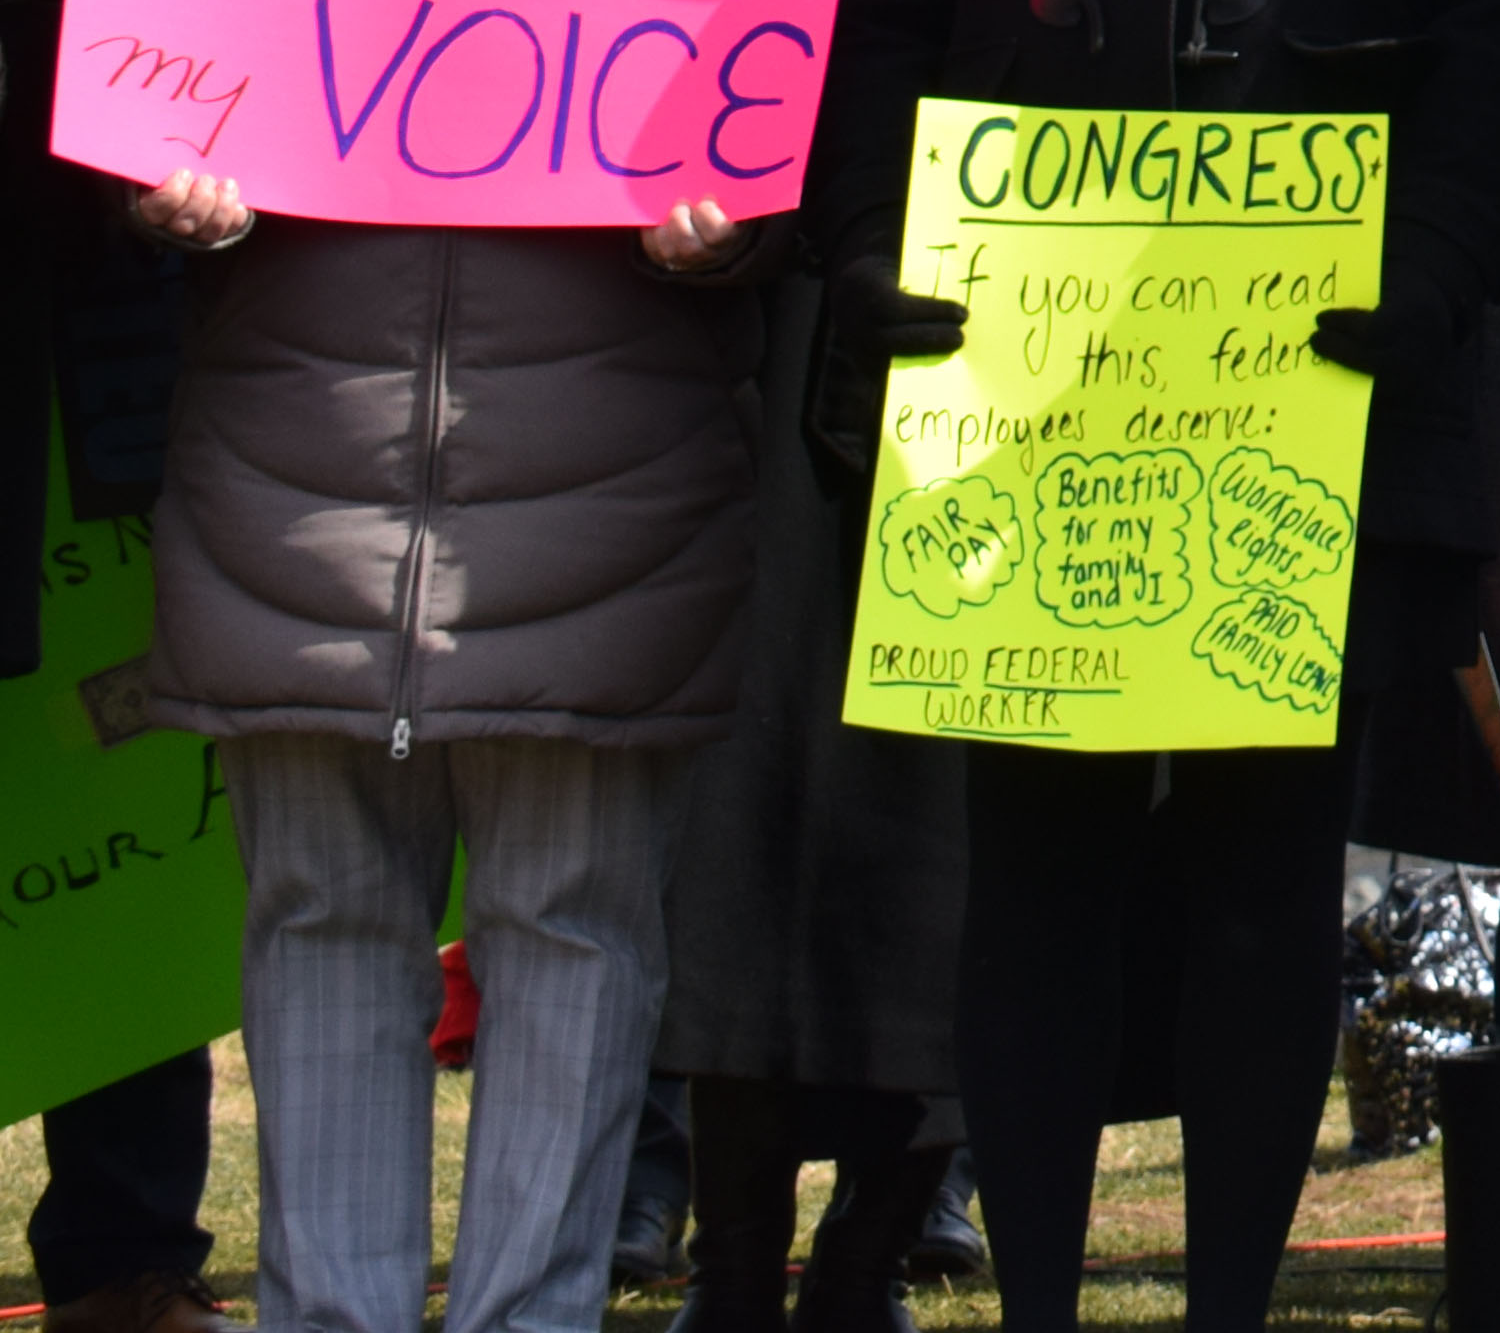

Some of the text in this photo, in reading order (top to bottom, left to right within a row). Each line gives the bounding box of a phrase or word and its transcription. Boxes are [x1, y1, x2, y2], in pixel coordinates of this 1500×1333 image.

[84, 36, 250, 158] my
[959, 114, 1380, 222] CONGRESS
[926, 243, 1337, 376] If you can read
[1077, 331, 1168, 394] this,
[896, 403, 1277, 477] employees deserve:
[1058, 462, 1183, 509] Benefits
[1220, 463, 1343, 553] Workplace
[902, 497, 969, 574] FAIR
[947, 517, 1009, 580] PAY
[1062, 516, 1153, 553] for my
[1058, 550, 1148, 601] family
[1071, 580, 1121, 610] and
[1243, 597, 1300, 639] PAID
[869, 643, 1130, 684] PROUD FEDERAL
[1209, 616, 1288, 684] FAMILY
[924, 690, 1060, 729] WORKER
[0, 832, 165, 929] OUR
